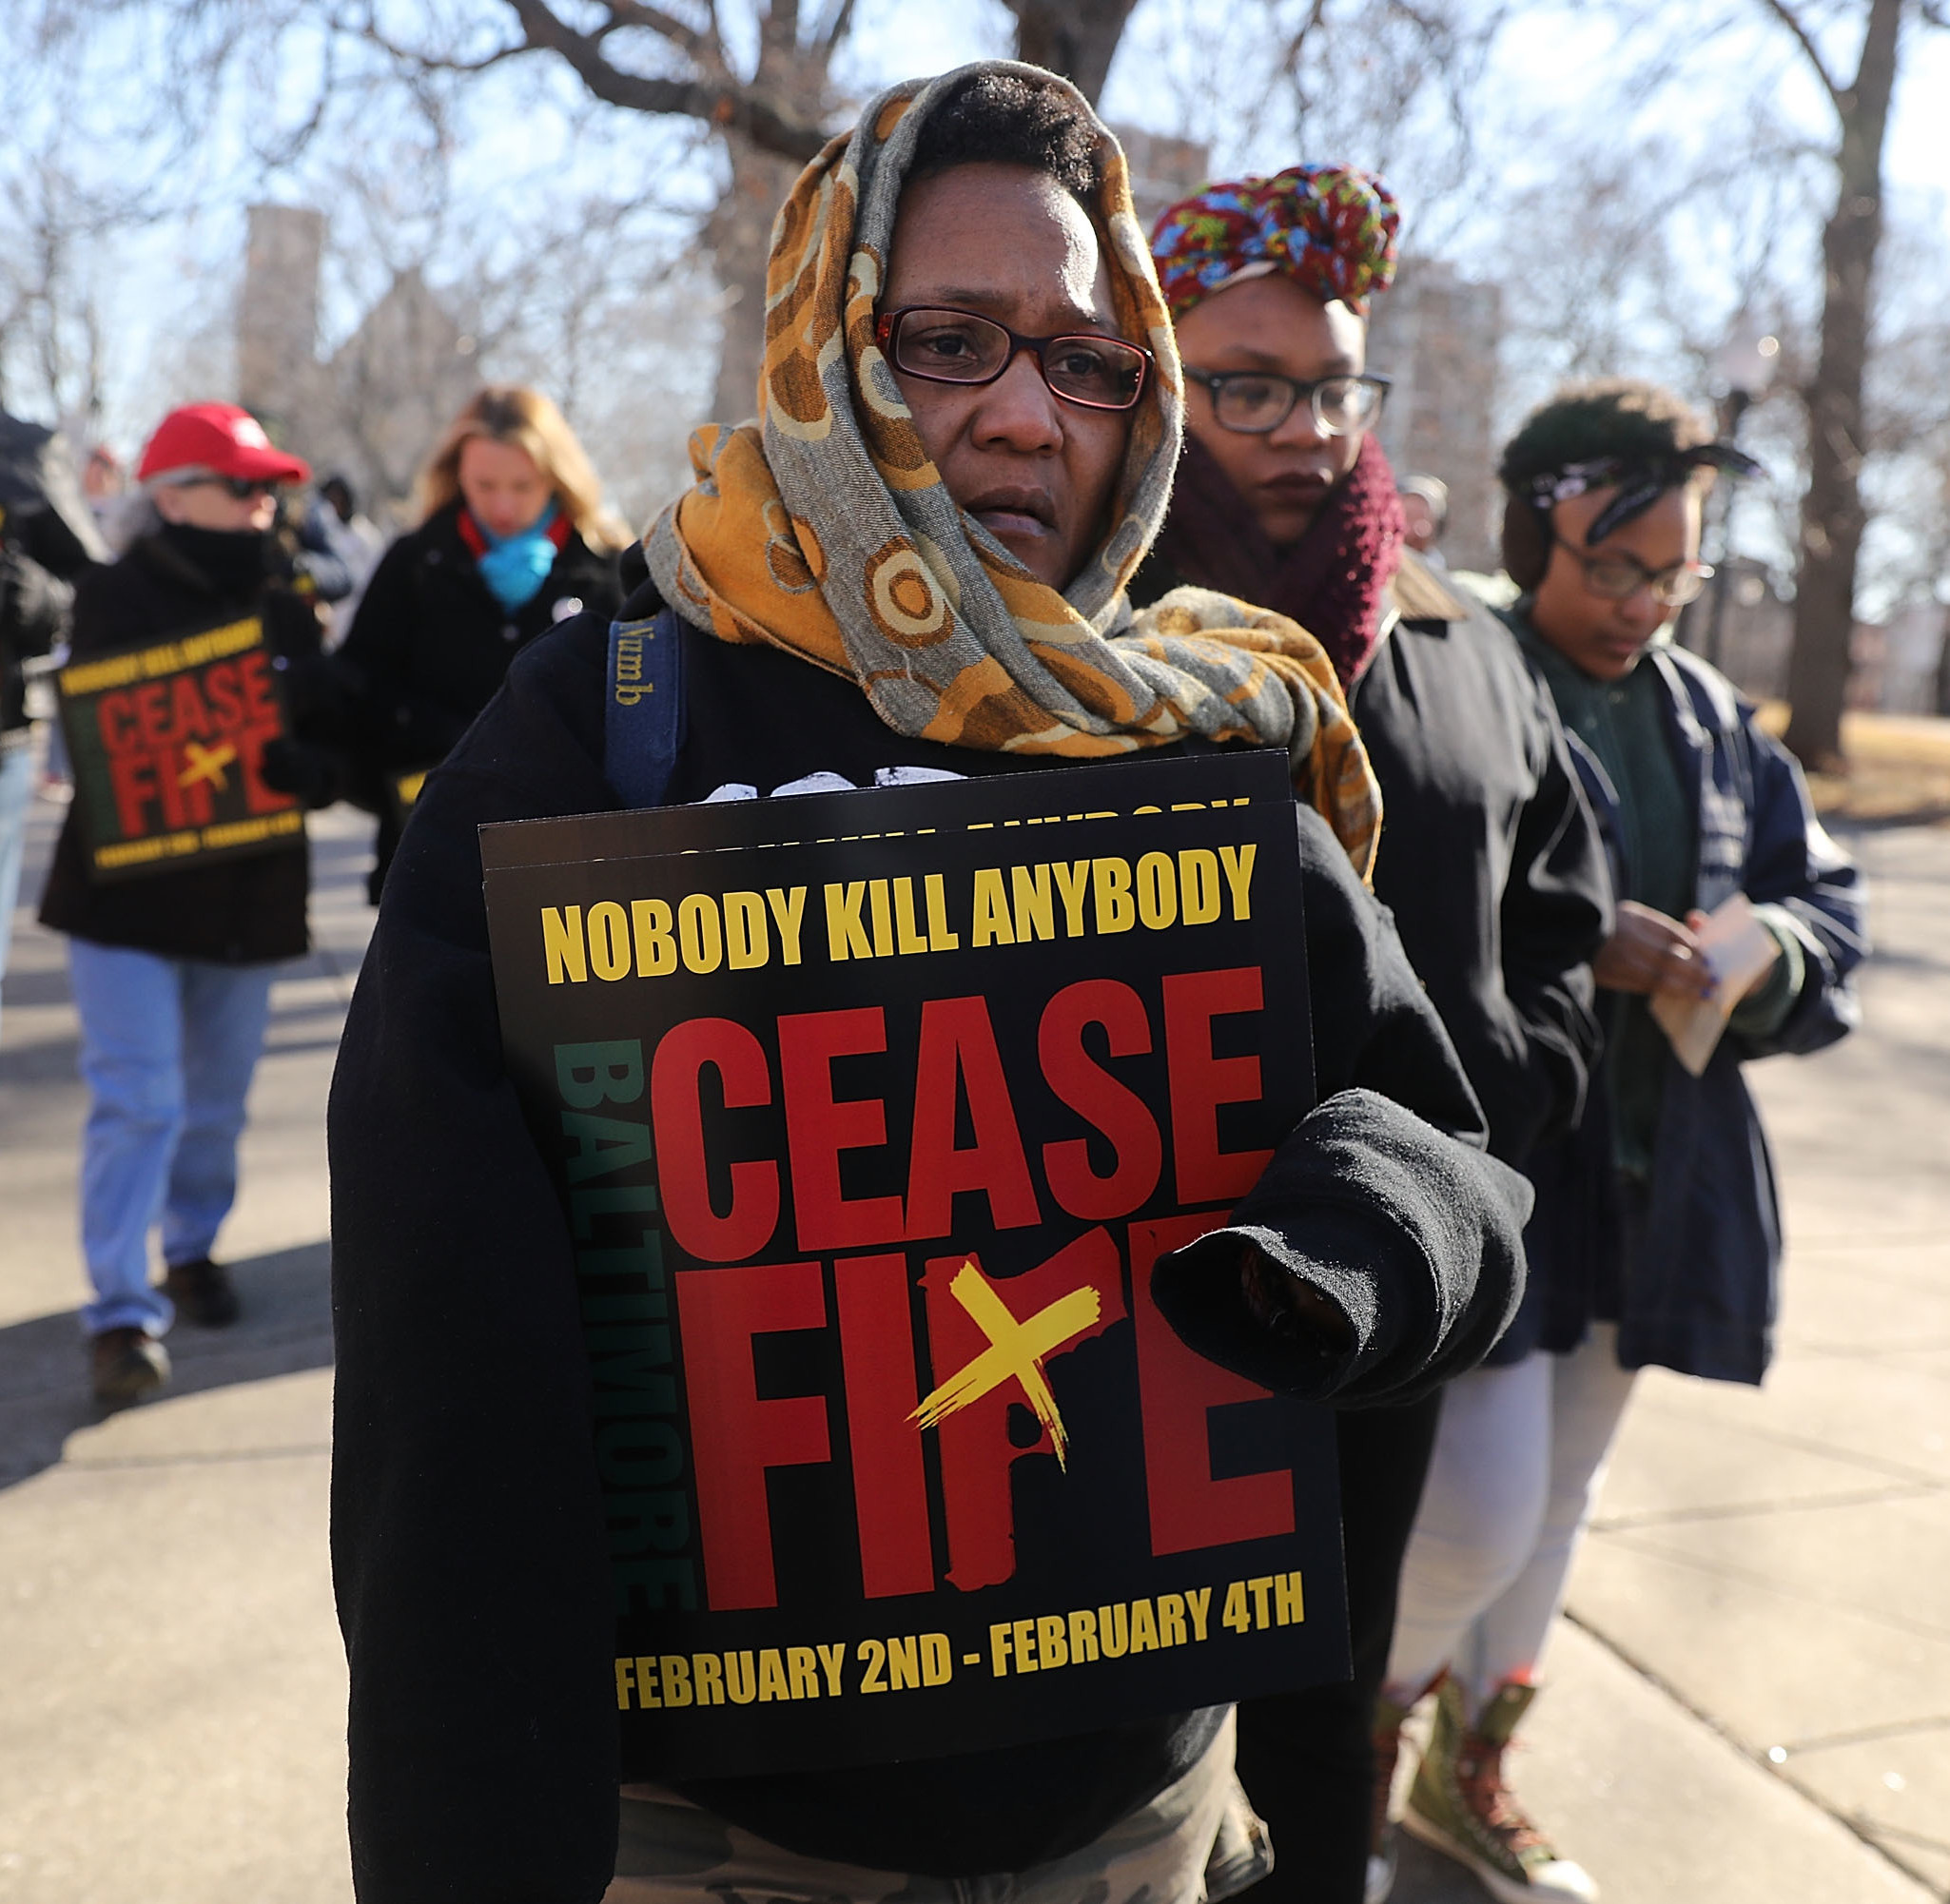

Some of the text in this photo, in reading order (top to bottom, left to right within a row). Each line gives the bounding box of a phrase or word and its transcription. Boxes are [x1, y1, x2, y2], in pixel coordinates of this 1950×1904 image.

[98, 650, 280, 754] CEASE
[540, 844, 1258, 985] NOBODY KILL ANYBODY
[651, 966, 1276, 1263] CEASE
[554, 1039, 698, 1615] BALTIMORE
[614, 1642, 847, 1710] FEBRUARY
[858, 1632, 953, 1694] 2ND
[989, 1587, 1213, 1678] FEBRUARY
[1221, 1570, 1305, 1635] 4TH
